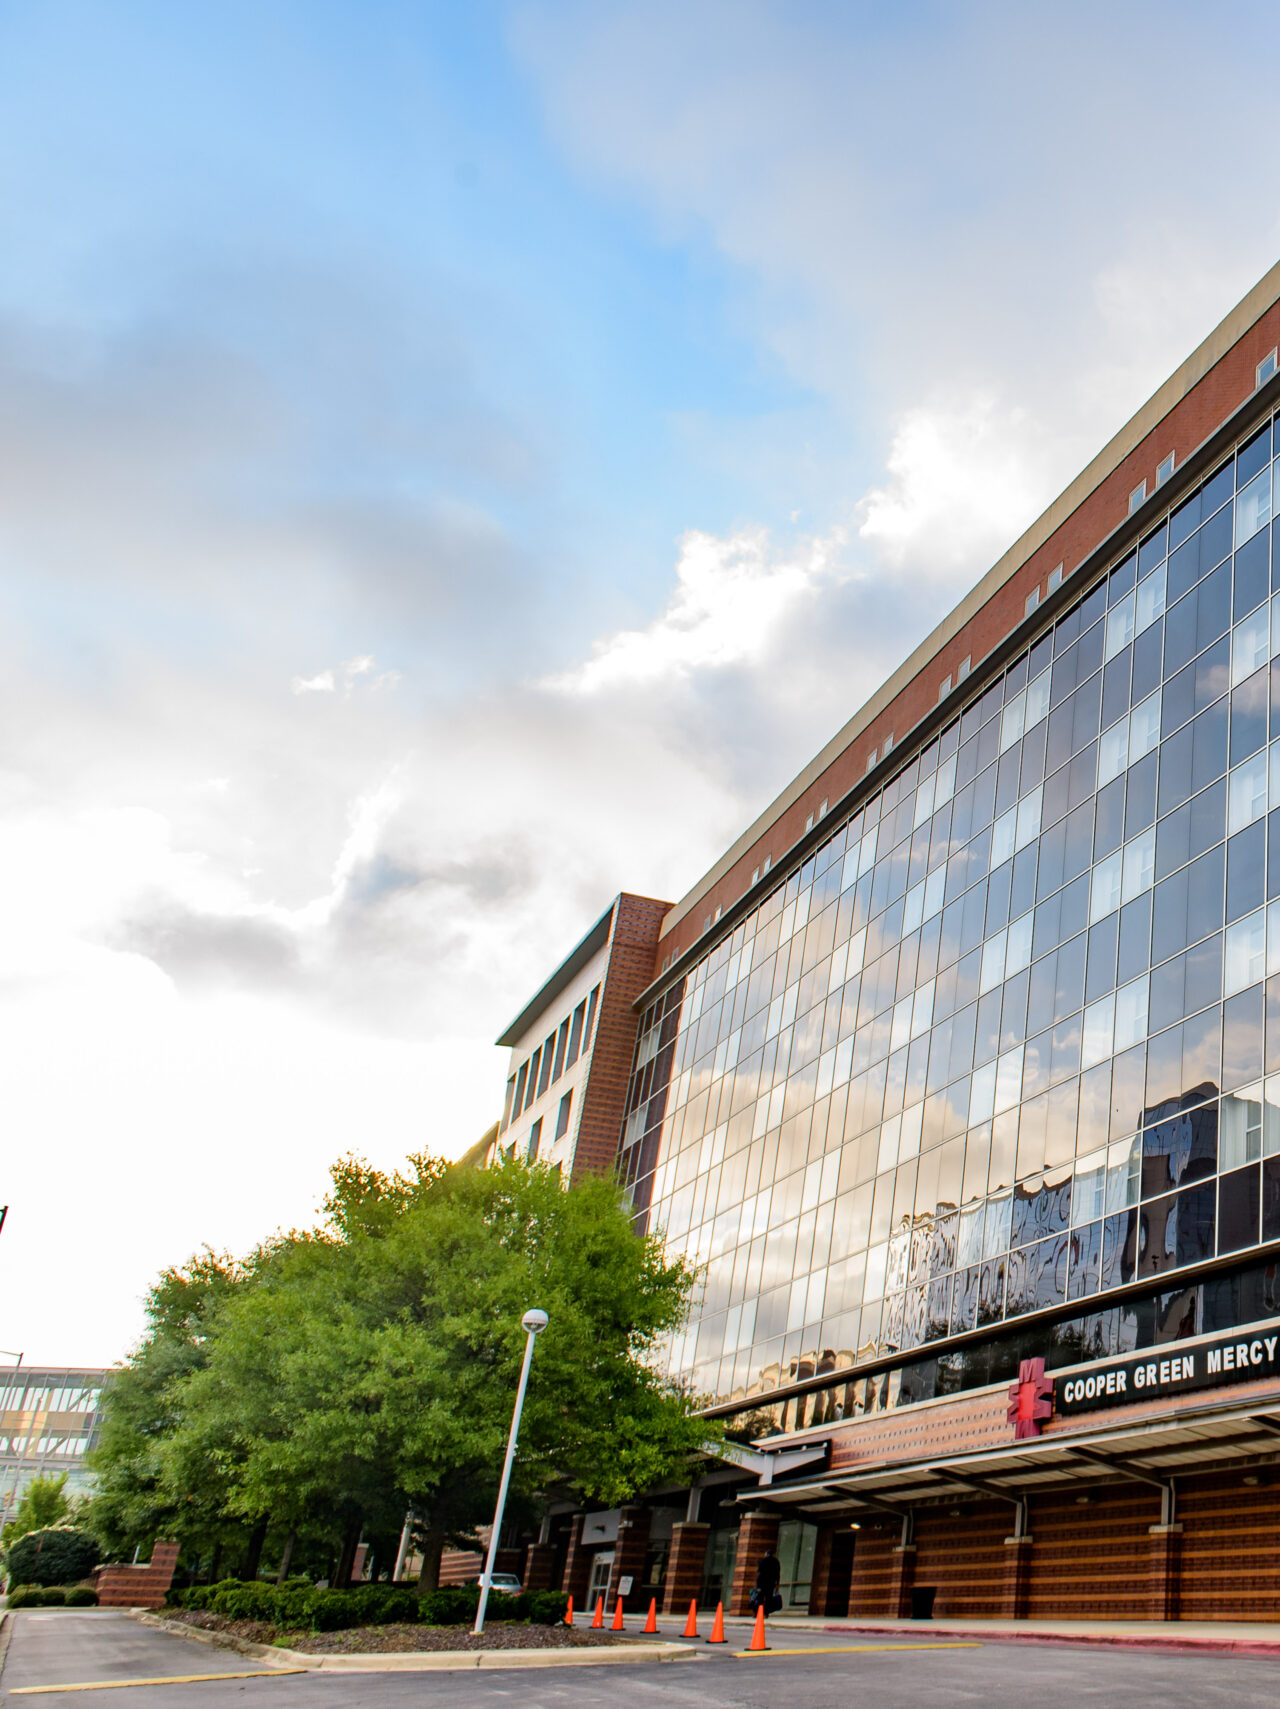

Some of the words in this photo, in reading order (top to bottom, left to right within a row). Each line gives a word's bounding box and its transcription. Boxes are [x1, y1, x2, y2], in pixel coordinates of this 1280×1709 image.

[1064, 1370, 1127, 1403] COOPER
[1133, 1355, 1195, 1388] GREEN
[1207, 1336, 1278, 1374] MERCY
